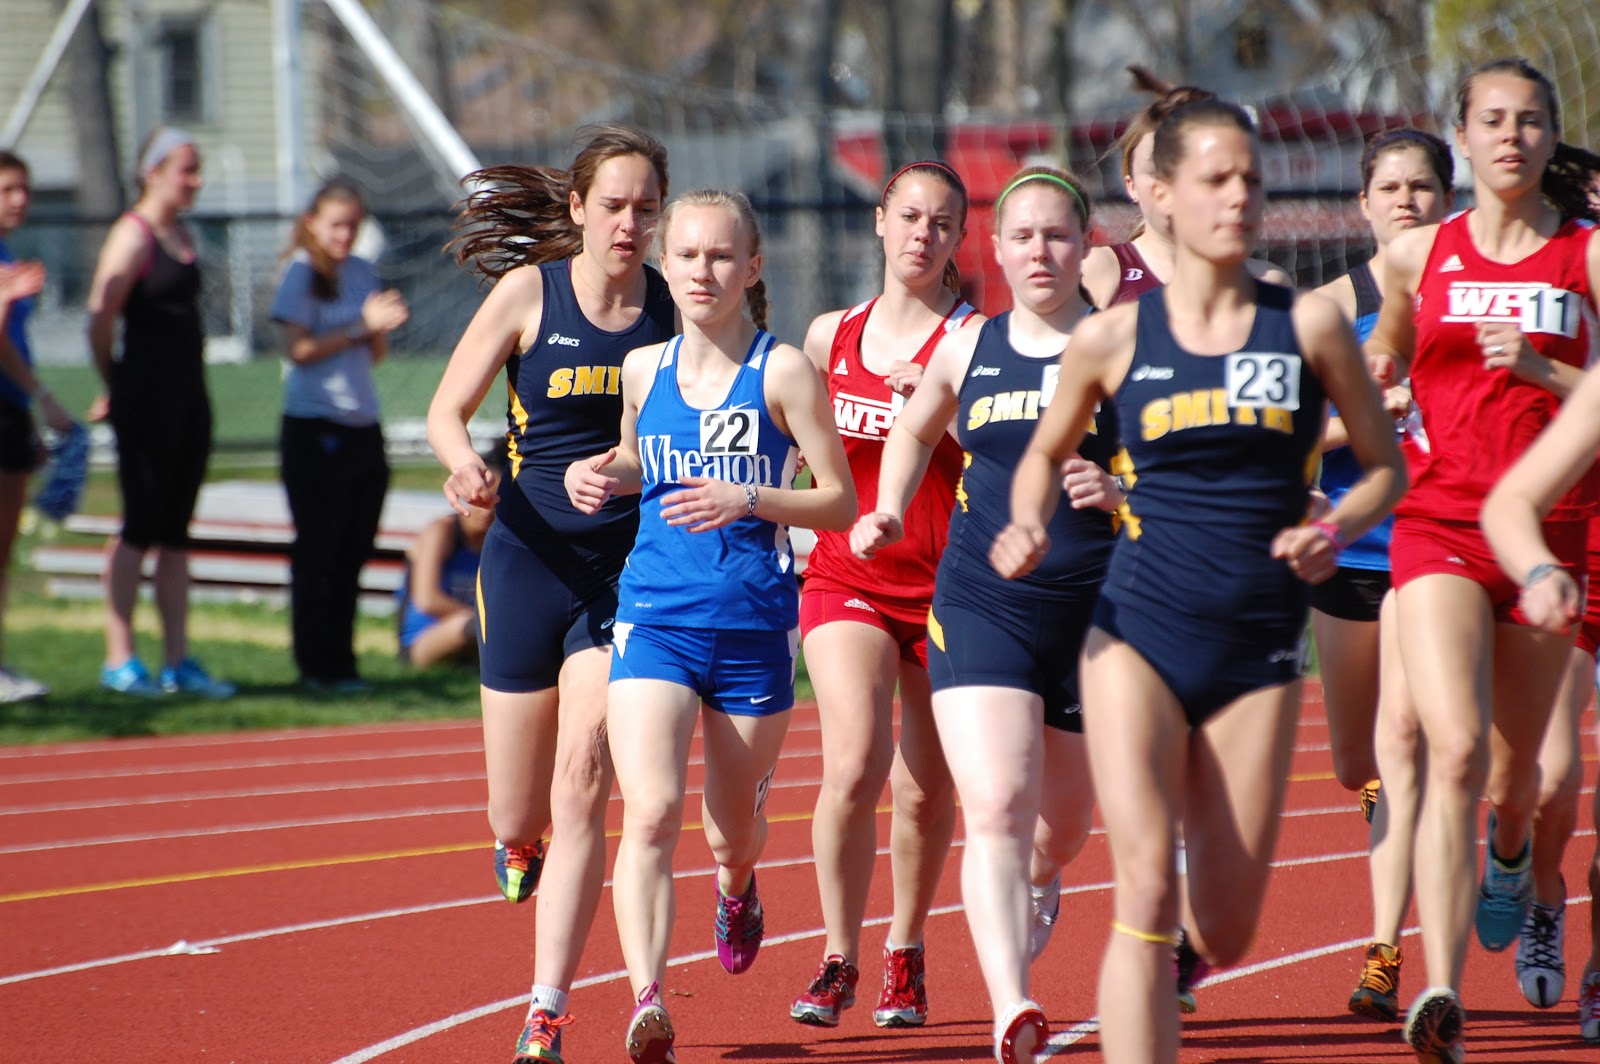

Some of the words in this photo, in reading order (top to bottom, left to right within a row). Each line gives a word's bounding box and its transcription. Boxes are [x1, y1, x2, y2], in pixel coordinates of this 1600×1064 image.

[1448, 287, 1522, 316] WP
[1529, 290, 1570, 333] 11
[558, 336, 580, 347] asics
[547, 366, 624, 398] SMI
[1236, 358, 1286, 401] 23
[834, 397, 896, 435] WP
[967, 390, 1042, 431] SMI
[703, 412, 750, 453] 22
[638, 434, 772, 486] Wheaton
